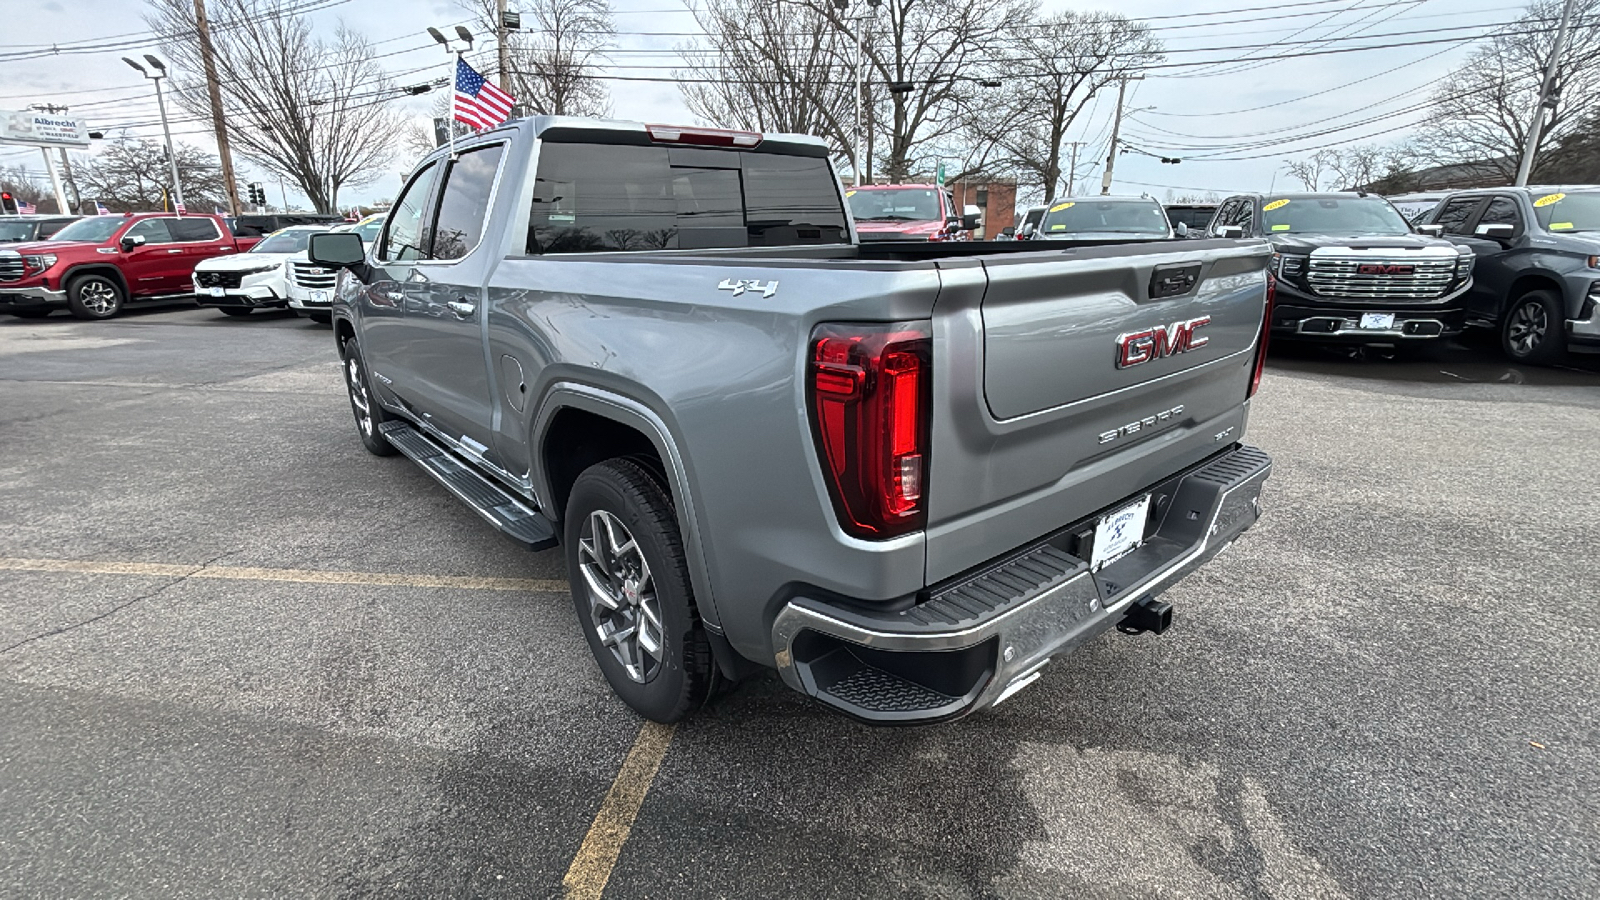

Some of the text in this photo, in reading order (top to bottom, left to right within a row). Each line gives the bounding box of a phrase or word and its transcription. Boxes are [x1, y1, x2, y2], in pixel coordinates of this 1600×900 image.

[35, 118, 76, 127] Albrecht
[1360, 265, 1413, 274] GMC
[1115, 314, 1211, 370] GMC
[1097, 404, 1185, 445] SIERRA
